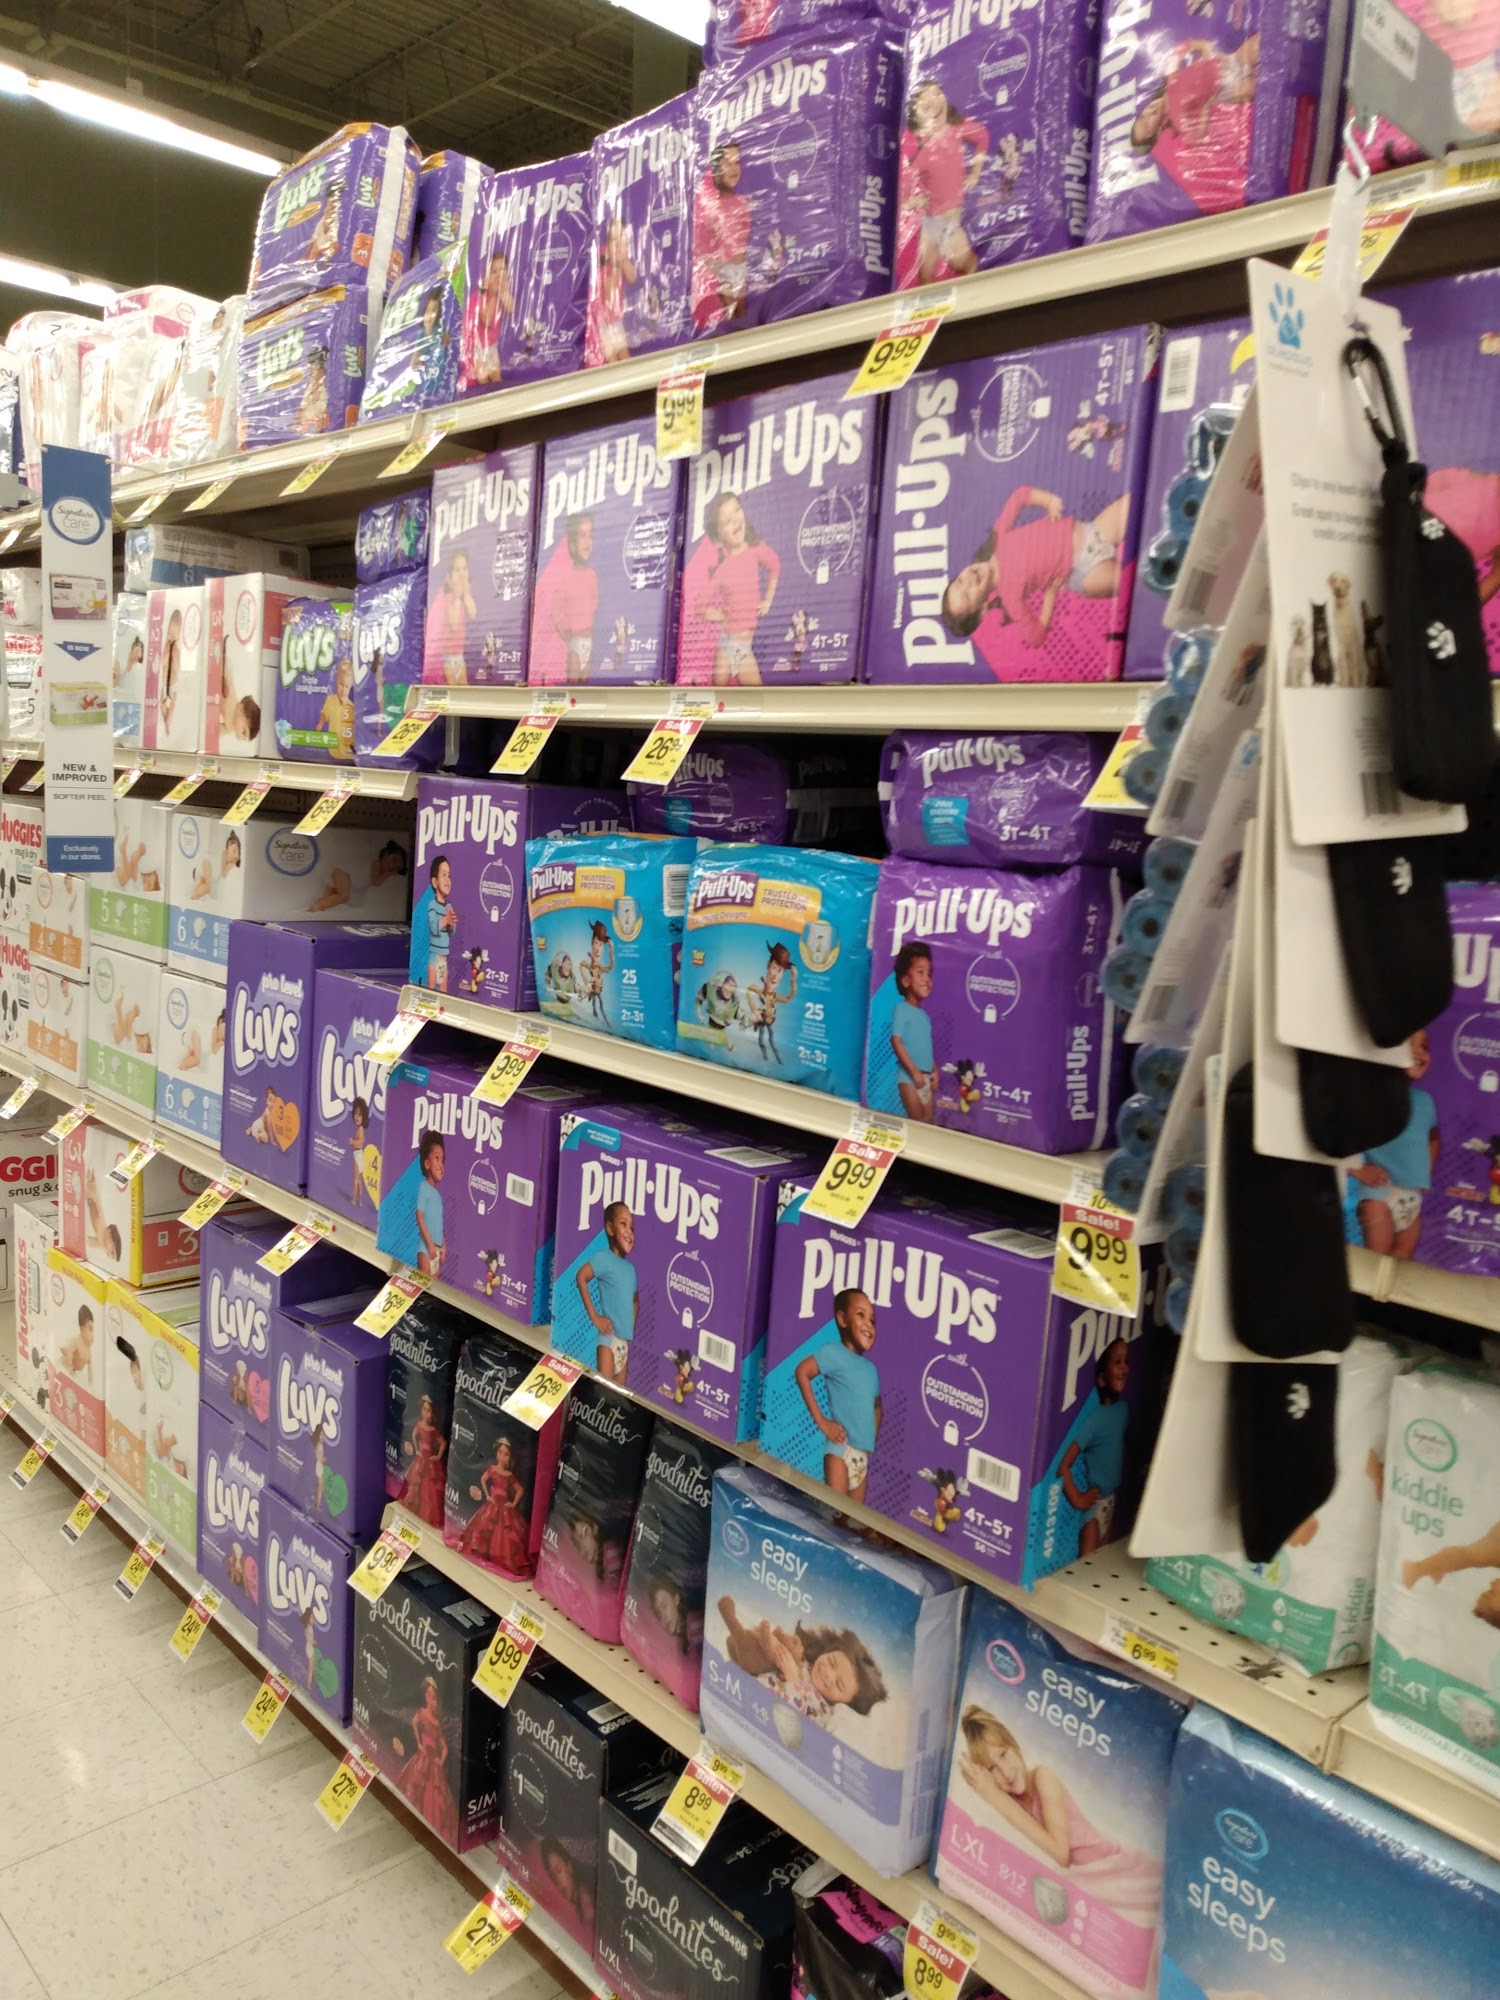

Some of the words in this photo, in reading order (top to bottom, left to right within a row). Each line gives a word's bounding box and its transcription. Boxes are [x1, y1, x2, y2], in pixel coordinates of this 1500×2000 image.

[357, 174, 375, 208] Luvs
[438, 209, 455, 243] Luvs
[1095, 343, 1114, 406] 4T-5T
[691, 401, 863, 542] Pull-Ups
[544, 433, 672, 550] Pull-Ups
[57, 505, 94, 519] Signature
[432, 470, 531, 567] Pull-Ups
[894, 378, 976, 666] Pull-Ups
[281, 624, 336, 688] Luvs
[353, 614, 402, 685] Luvs
[812, 633, 848, 648] 4T-5T
[28, 697, 35, 714] 5
[527, 716, 550, 727] Sale!
[52, 773, 108, 783] IMPROVED
[62, 763, 88, 772] NEW
[90, 764, 97, 772] &
[922, 737, 1025, 788] Pull-Ups
[53, 793, 84, 801] SOFTER
[0, 813, 42, 848] HUGGIES
[417, 795, 519, 867] Pull-Ups
[1000, 825, 1051, 841] 3T-4T
[63, 844, 99, 854] Exclusively
[482, 881, 514, 893] OUTSTANDING
[482, 887, 512, 899] PROTECTION
[532, 865, 574, 900] Pull-Ups
[697, 875, 755, 907] Pull-Ups
[764, 889, 798, 900] TRUSTED
[101, 900, 109, 922] 5
[762, 898, 808, 912] PROTECTION
[177, 917, 187, 941] 6
[891, 888, 1036, 957] Pull-Ups
[486, 968, 510, 982] 2T-3T
[622, 969, 637, 984] 25
[805, 1002, 825, 1020] 25
[234, 989, 298, 1069] Luvs
[509, 1044, 533, 1058] Sale!
[321, 1033, 387, 1119] Luvs
[1066, 1025, 1094, 1121] Pull-Ups
[165, 1085, 174, 1110] 6
[983, 1082, 1032, 1103] 3T-4T
[411, 1093, 504, 1154] Pull-Ups
[371, 1155, 379, 1172] 4
[847, 1142, 883, 1161] Sale!
[8, 1185, 41, 1198] snug
[43, 1182, 52, 1192] &
[578, 1157, 720, 1244] Pull-Ups
[1074, 1208, 1120, 1232] Sale!
[178, 1227, 199, 1256] 3
[395, 1279, 416, 1293] Sale!
[501, 1274, 527, 1292] 3T-4T
[670, 1271, 711, 1294] OUTSTANDING
[670, 1279, 710, 1304] PROTECTION
[798, 1238, 998, 1345] Pull-Ups
[210, 1276, 267, 1351] Luvs
[389, 1332, 441, 1373] goodnites
[547, 1359, 572, 1378] Sale!
[280, 1360, 338, 1439] Luvs
[456, 1368, 509, 1407] goodnit
[697, 1380, 731, 1406] 4T-5T
[925, 1386, 983, 1418] PROTECTION
[926, 1376, 984, 1409] OUTSTANDING
[568, 1395, 630, 1445] goodnites
[646, 1448, 711, 1508] goodnites
[1390, 1466, 1464, 1517] kiddie
[207, 1456, 259, 1539] Luvs
[965, 1507, 1013, 1539] 4T-5T
[1401, 1508, 1446, 1539] ups
[385, 1535, 406, 1554] Sale!
[762, 1538, 808, 1581] easy
[268, 1538, 328, 1625] Luvs
[750, 1560, 812, 1614] sleeps
[369, 1598, 448, 1672] goodnites
[505, 1625, 528, 1647] Sale!
[708, 1660, 742, 1700] S-M
[1043, 1667, 1105, 1719] easy
[353, 1698, 369, 1723] S/M
[1025, 1689, 1111, 1756] sleeps
[515, 1709, 590, 1780] goodnites
[348, 1758, 367, 1780] Sale!
[694, 1768, 725, 1794] Sale!
[467, 1791, 496, 1815] S/M
[1203, 1856, 1276, 1921] easy
[491, 1900, 515, 1925] Sale!
[1187, 1882, 1286, 1964] sleeps
[624, 1874, 729, 1984] goodnites
[600, 1940, 622, 1973] L/XL
[917, 1936, 955, 1969] Sale!
